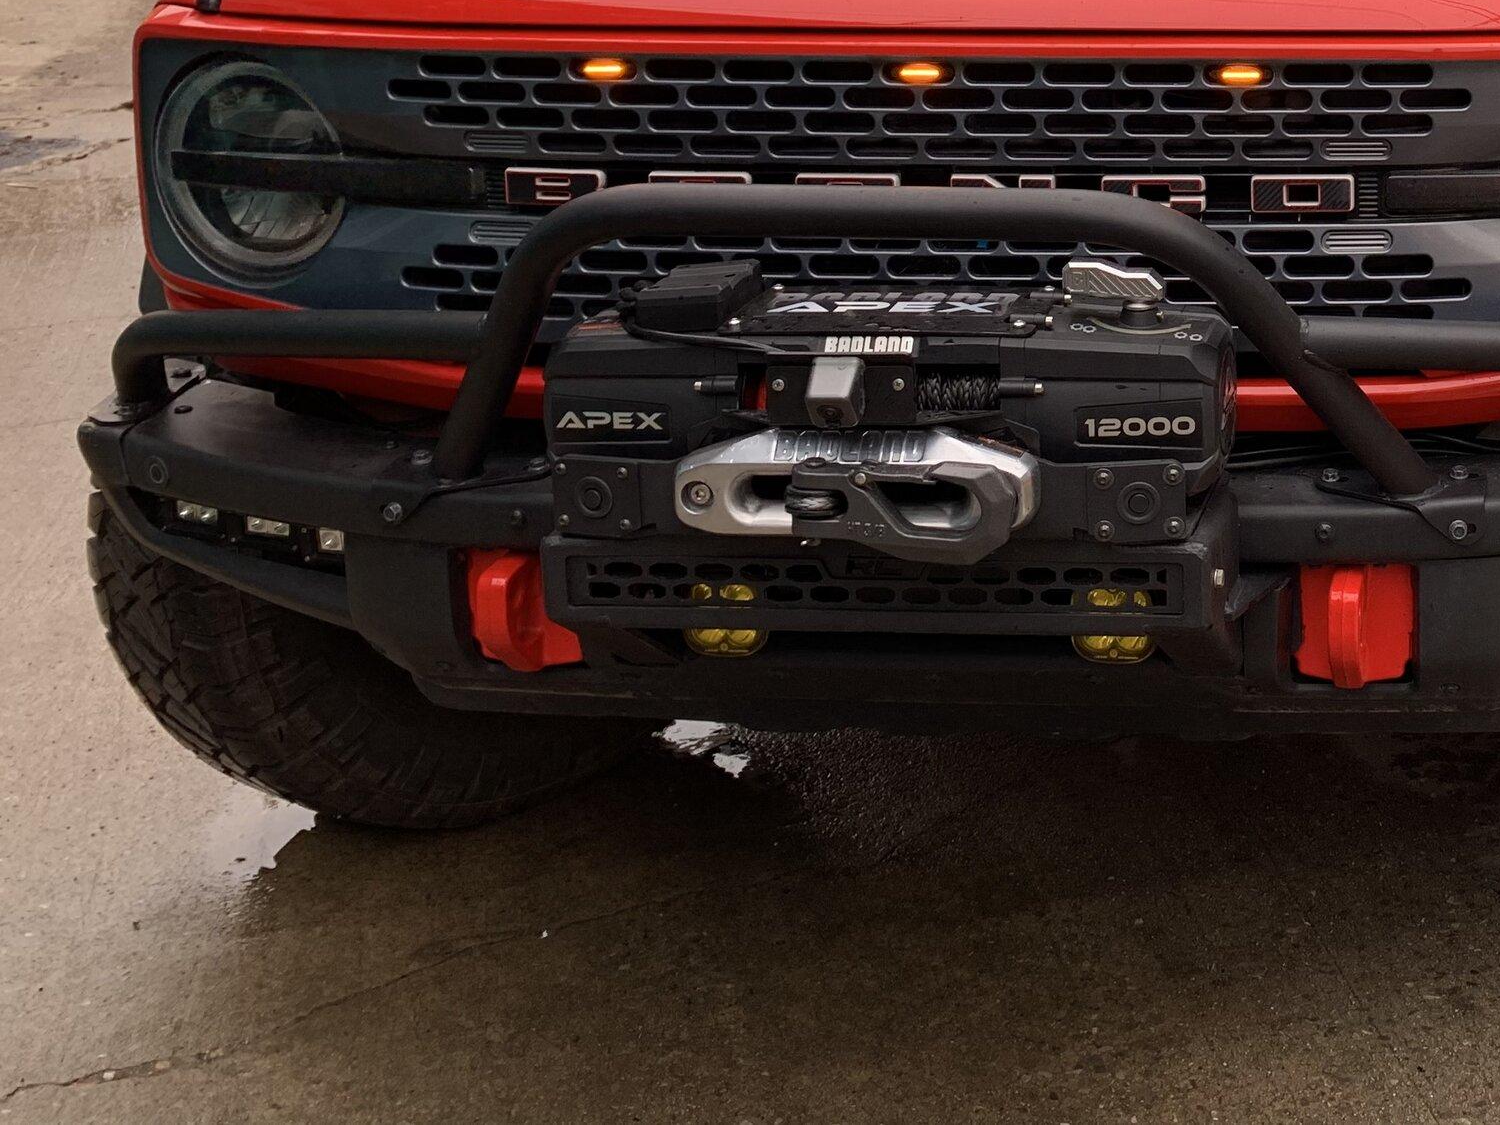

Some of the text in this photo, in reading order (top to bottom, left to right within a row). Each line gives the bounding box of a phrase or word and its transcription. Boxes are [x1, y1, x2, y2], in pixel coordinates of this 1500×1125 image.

[766, 301, 1001, 313] APEX
[824, 336, 914, 354] BADLAND
[556, 410, 666, 430] APEX
[1084, 416, 1196, 438] 12000
[772, 430, 929, 464] BADLAND
